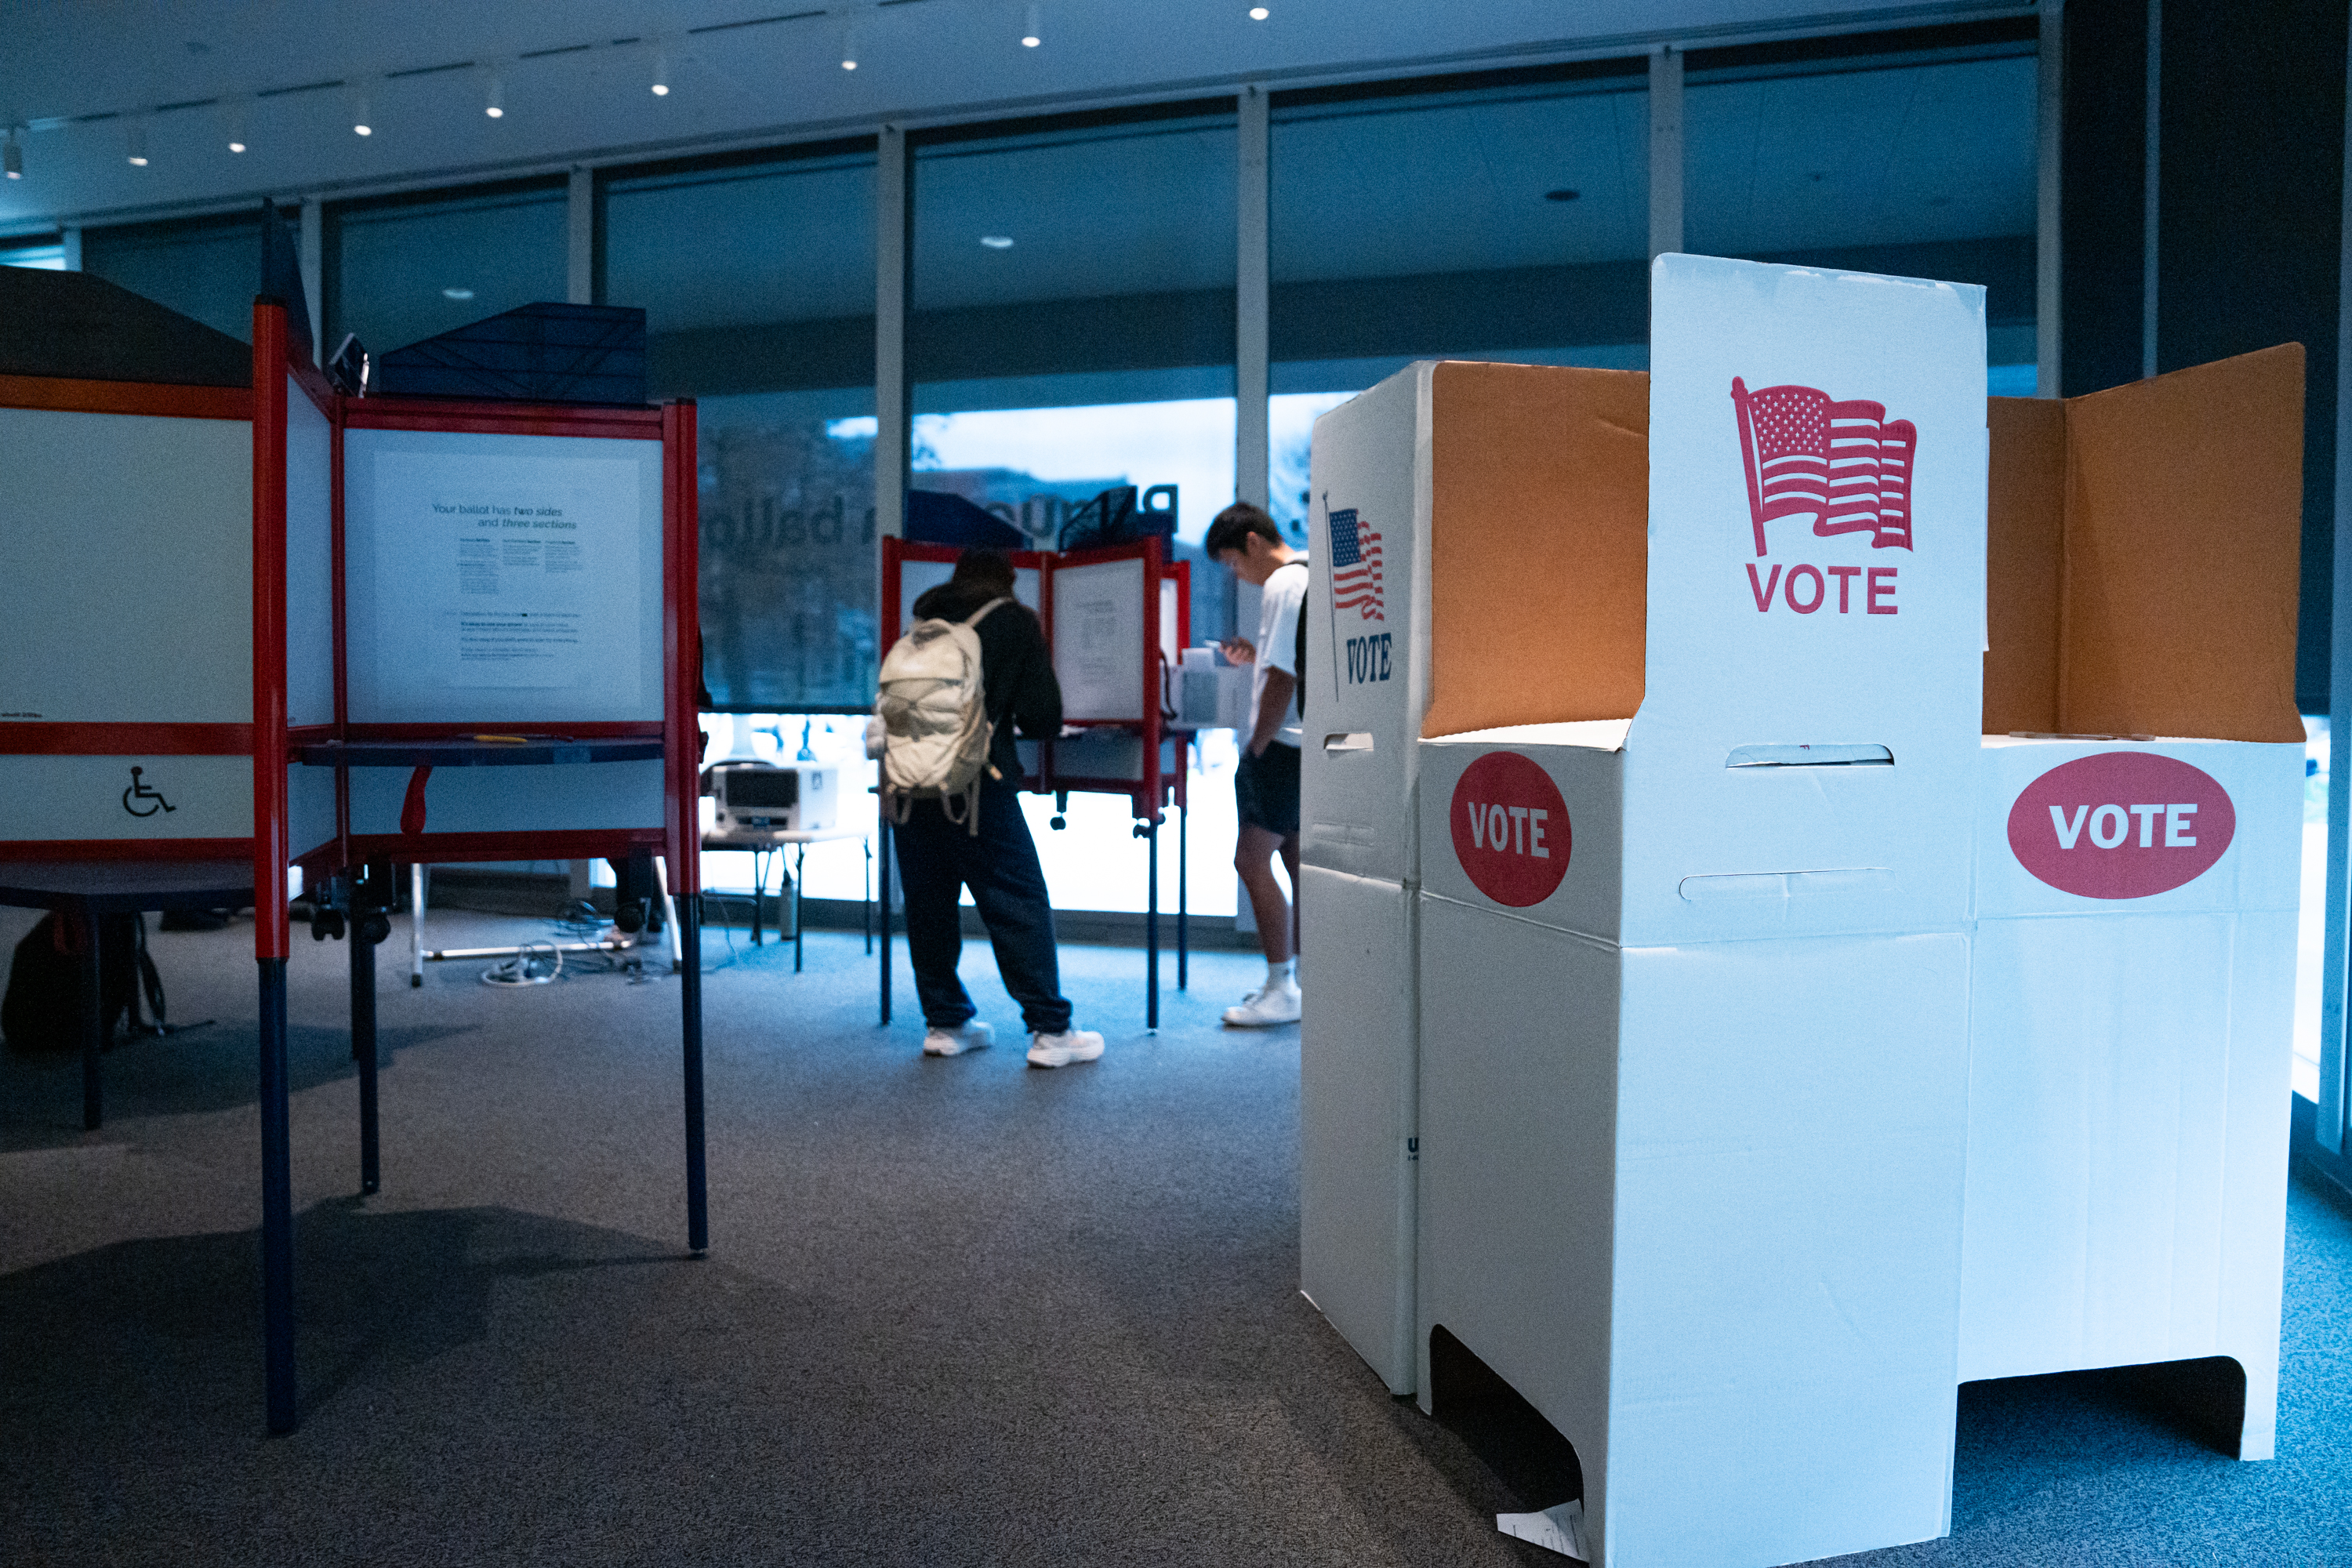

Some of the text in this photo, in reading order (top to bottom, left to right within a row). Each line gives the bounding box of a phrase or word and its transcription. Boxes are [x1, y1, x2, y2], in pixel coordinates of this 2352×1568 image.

[433, 503, 562, 517] Your ballot has two sides
[478, 517, 577, 529] and three sections
[1745, 563, 1898, 615] VOTE
[1346, 632, 1392, 684] VOTE
[1468, 801, 1549, 859] VOTE
[2049, 803, 2198, 850] VOTE
